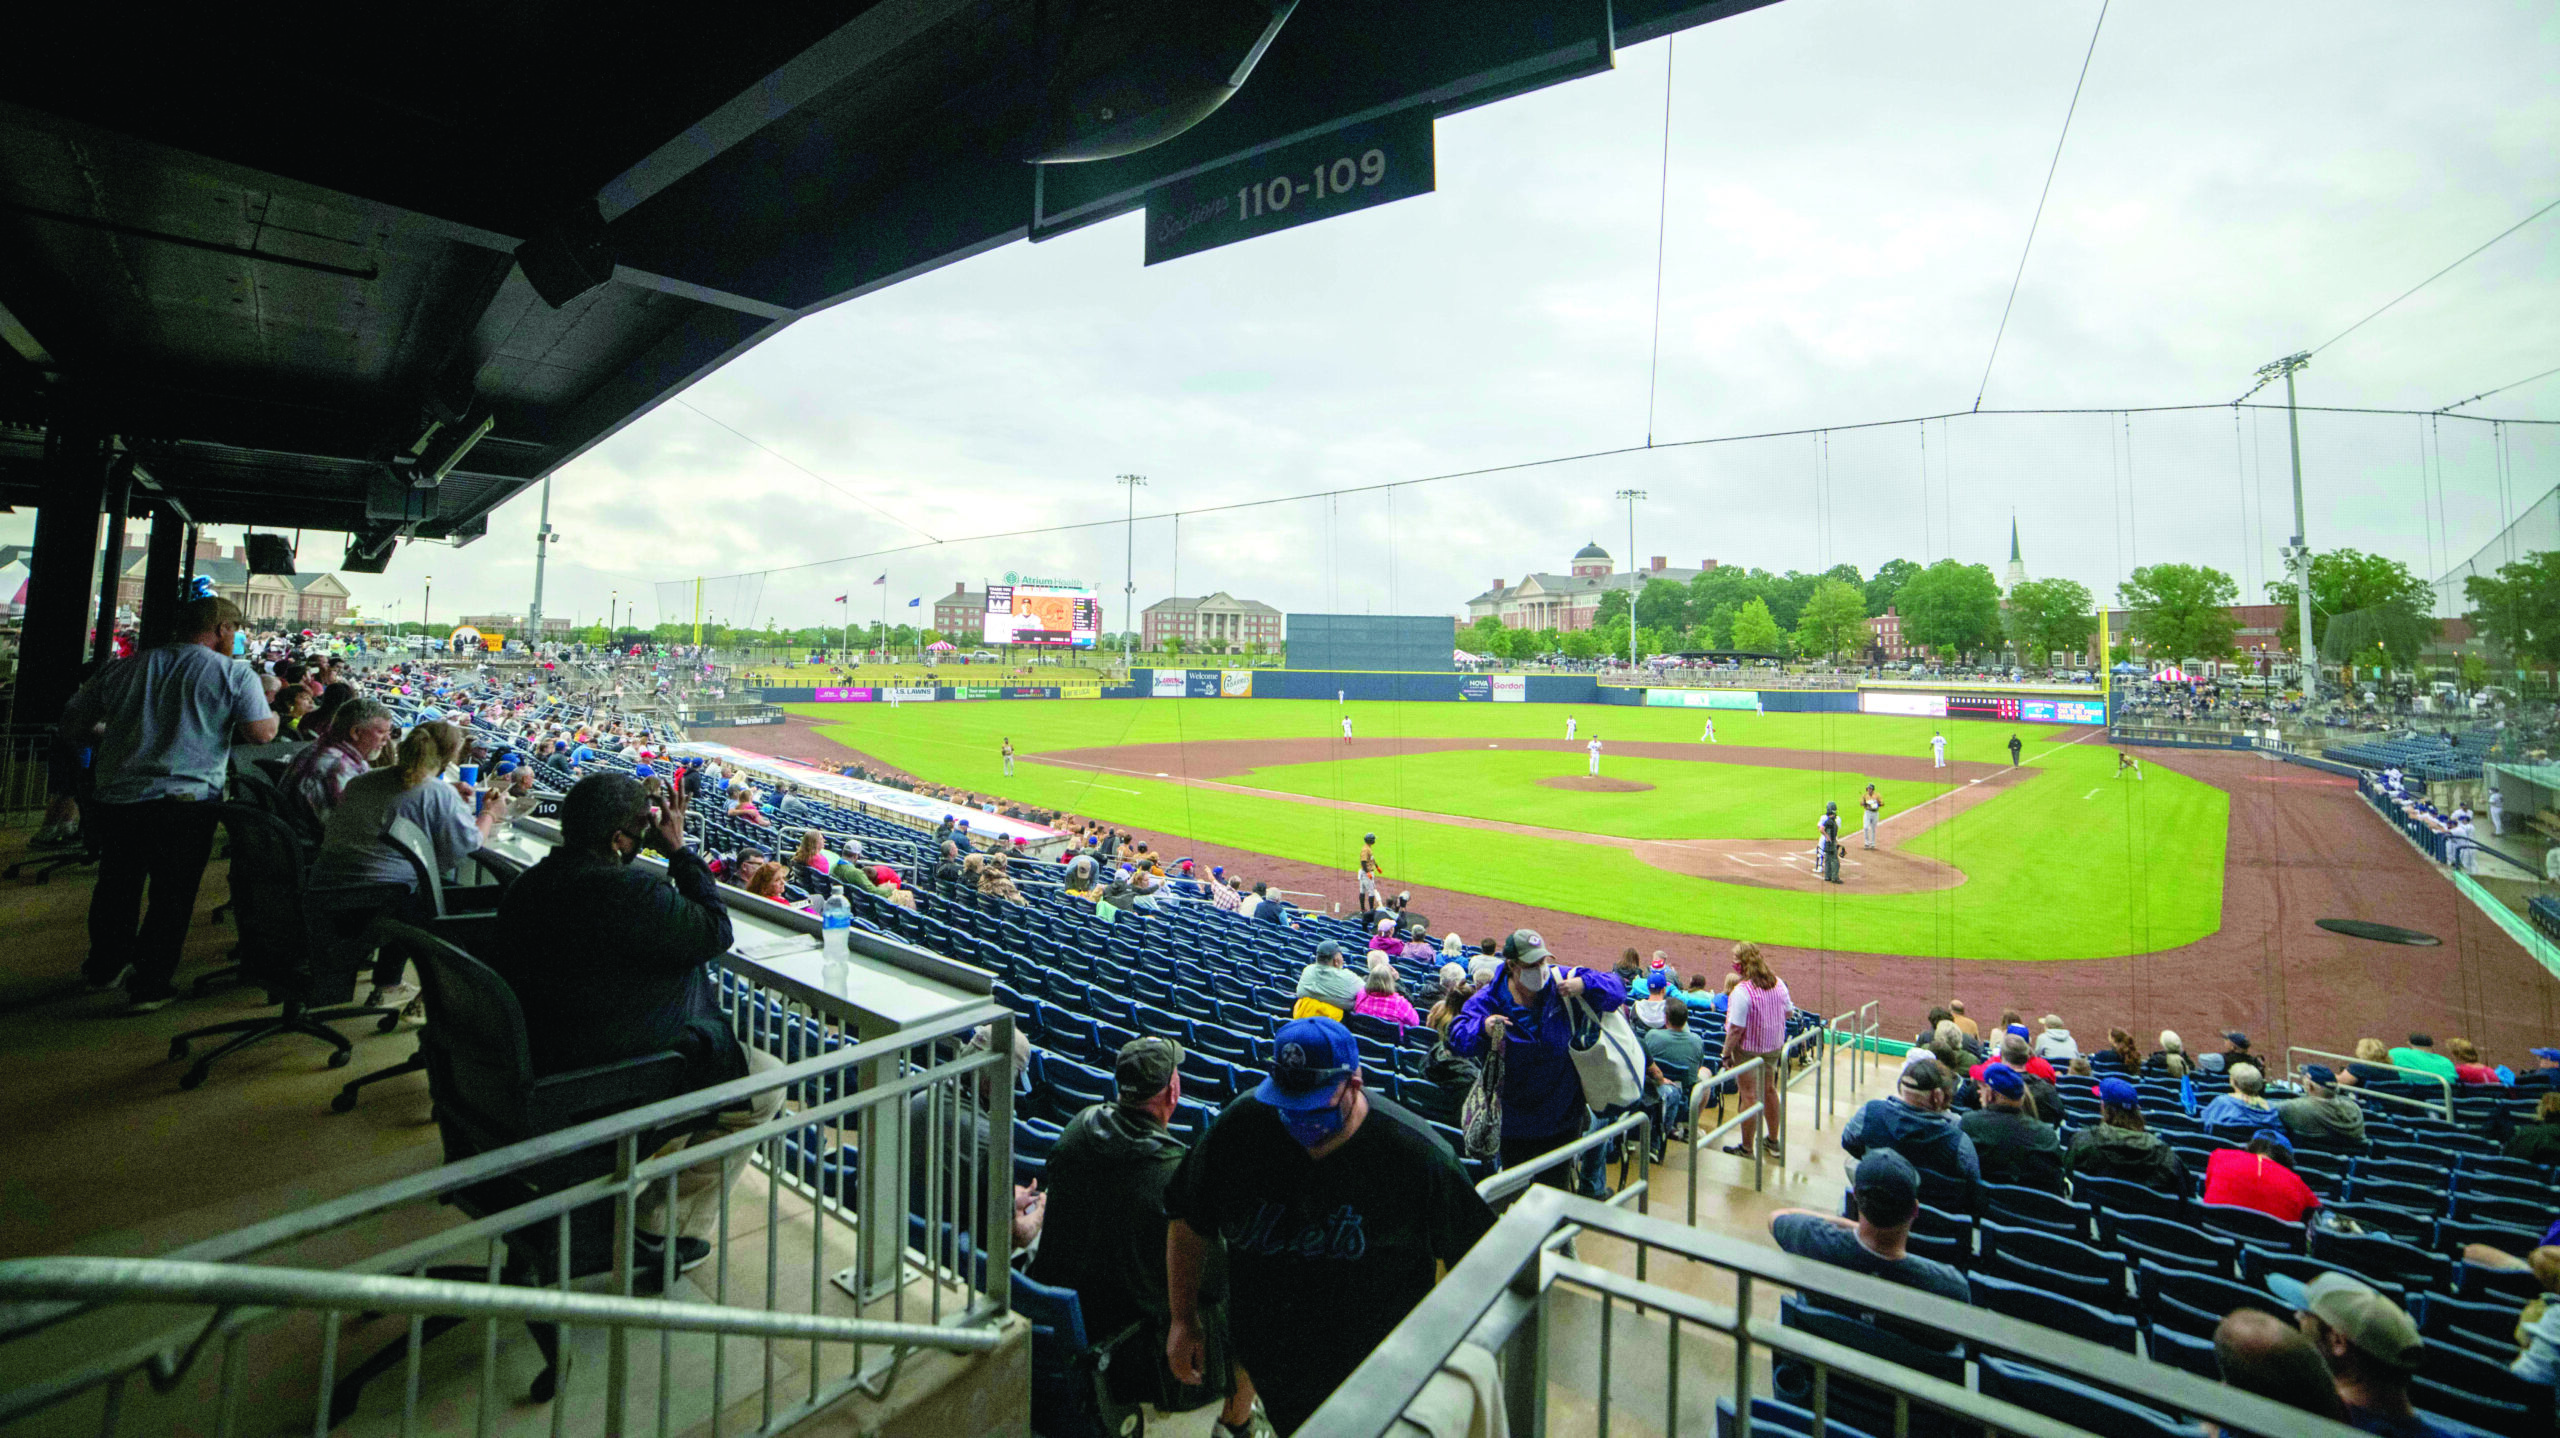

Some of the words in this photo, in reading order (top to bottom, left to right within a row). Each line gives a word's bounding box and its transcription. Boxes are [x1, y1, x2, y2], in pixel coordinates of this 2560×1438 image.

[1237, 148, 1386, 221] 110-109
[1021, 576, 1053, 585] Atrium
[1054, 577, 1083, 587] Health
[1189, 672, 1218, 680] Welcome
[538, 803, 557, 814] 110
[1229, 1203, 1366, 1259] Mets
